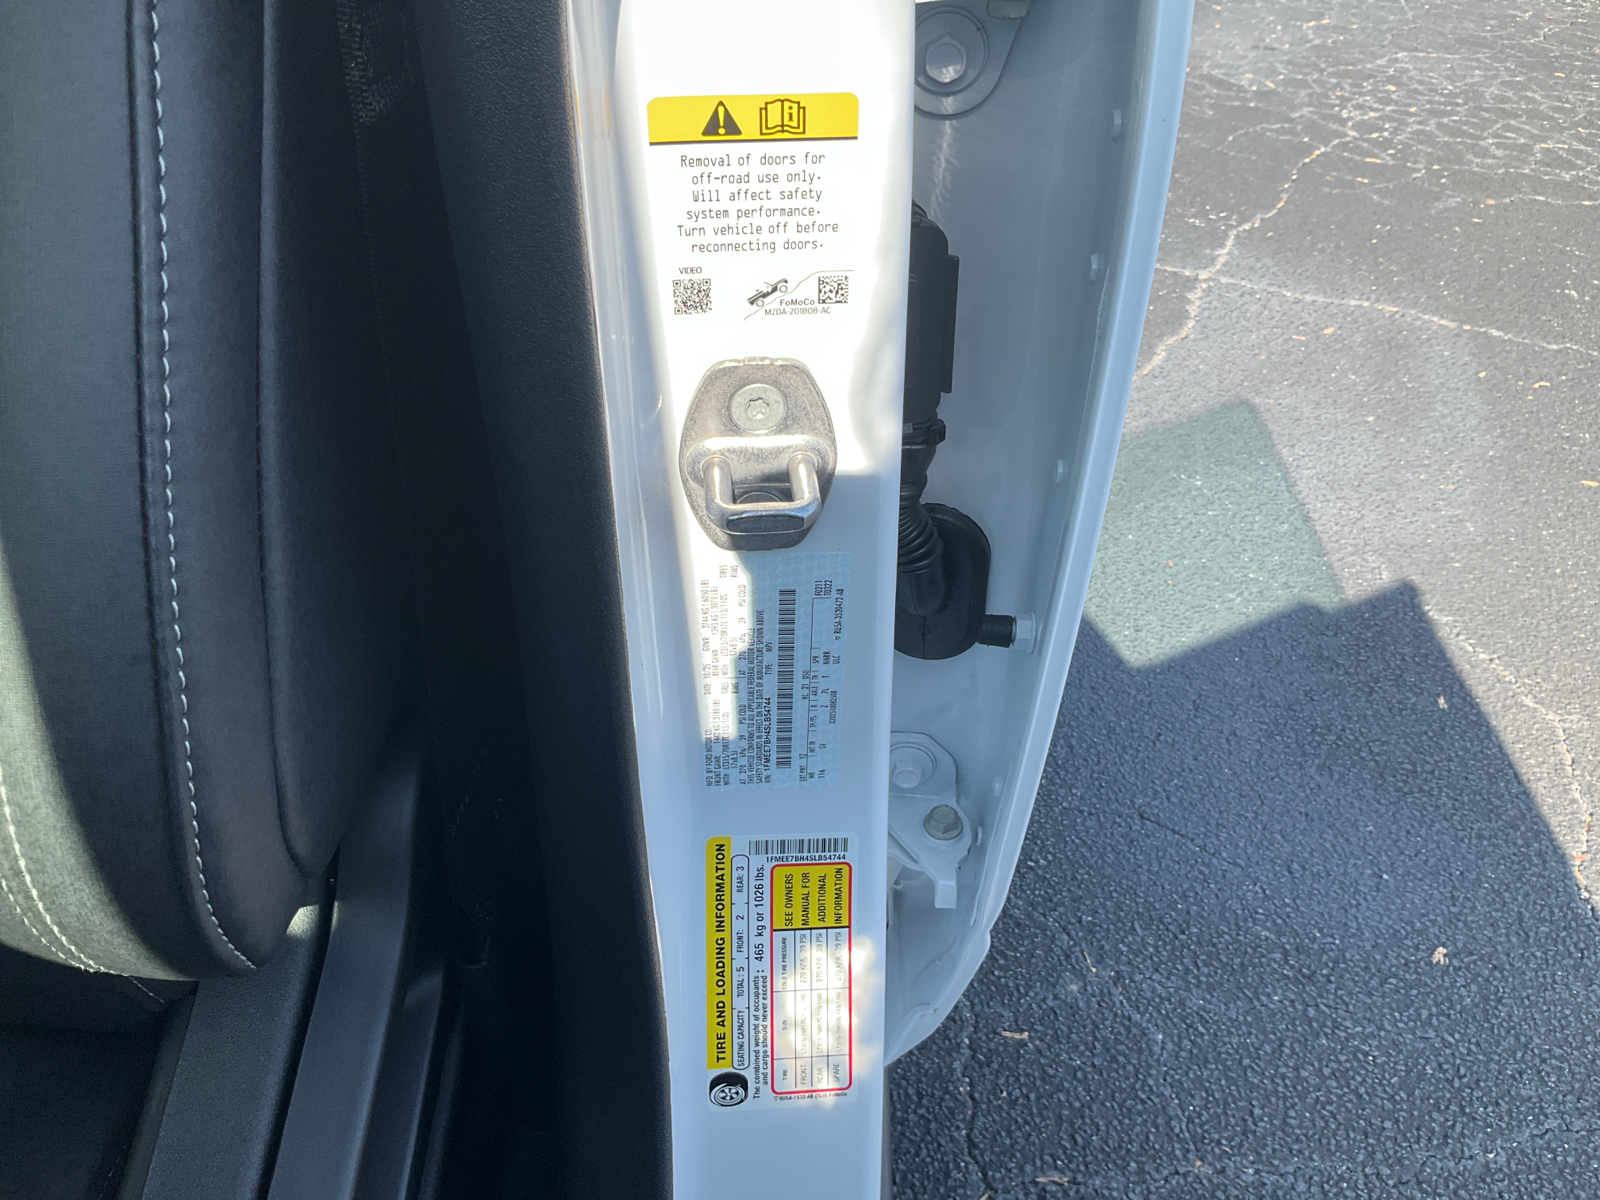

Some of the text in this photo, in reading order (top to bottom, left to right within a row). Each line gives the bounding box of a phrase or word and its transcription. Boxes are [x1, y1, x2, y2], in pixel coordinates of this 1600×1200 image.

[680, 152, 825, 168] Removal of doors for
[692, 170, 821, 185] off-road use only.
[692, 187, 822, 202] Will affect safety
[686, 205, 821, 222] system performance.
[677, 221, 839, 237] Turn vehicle off before
[691, 238, 824, 253] reconnecting doors.
[678, 266, 702, 275] VIDEO
[780, 298, 815, 307] FoMoCo
[720, 565, 728, 578] TIRES
[729, 565, 738, 578] RIMS
[701, 589, 710, 603] 6050
[738, 584, 746, 597] COLD
[701, 616, 710, 629] 2744
[711, 622, 719, 635] 1393
[747, 627, 755, 647] VEHICLE
[755, 627, 764, 646] SHOWN
[764, 642, 772, 652] MPV
[738, 651, 746, 660] 270
[747, 648, 755, 665] MOTOR
[755, 646, 764, 680] MANUFACTURE
[812, 655, 820, 664] SPR
[832, 655, 840, 664] ULC
[702, 664, 710, 679] 10/25
[711, 664, 719, 676] REAR
[747, 665, 755, 686] FEDERAL
[747, 686, 755, 713] APPLICABLE
[755, 688, 764, 700] DATE
[738, 704, 746, 716] COLD
[755, 701, 764, 710] THE
[713, 708, 721, 720] 3180
[747, 714, 755, 722] ALL
[755, 718, 764, 733] EFFECT
[713, 732, 721, 744] 1442
[747, 729, 755, 753] CONFORMS
[755, 740, 764, 766] STANDARDS
[738, 765, 746, 774] 270
[747, 754, 755, 773] VEHICLE
[713, 771, 721, 787] FRONT
[747, 774, 755, 784] THIS
[755, 767, 764, 784] SAFETY
[817, 769, 826, 779] 116
[766, 854, 846, 863] 1FMEE7BH4SLB54744
[754, 864, 764, 881] lbs.
[736, 874, 744, 893] REAR:
[754, 883, 765, 908] 1026
[784, 873, 794, 927] SEE OWNERS
[800, 872, 810, 926] MANUAL FOR
[817, 873, 827, 923] ADDITIONAL
[834, 867, 844, 924] INFORMATION
[756, 911, 765, 922] or
[754, 925, 766, 937] kg
[736, 929, 744, 953] FRONT:
[799, 944, 807, 953] 39
[816, 944, 823, 952] 39
[834, 943, 842, 951] 39
[715, 843, 726, 1063] TIRE AND LOADING INFORMATION
[754, 943, 765, 962] 465
[752, 975, 762, 1012] occupants
[737, 1010, 745, 1067] SEATING CAPACITY
[752, 1023, 761, 1048] weight
[760, 1024, 769, 1048] should
[762, 1050, 770, 1070] cargo
[832, 1062, 840, 1082] SPARE
